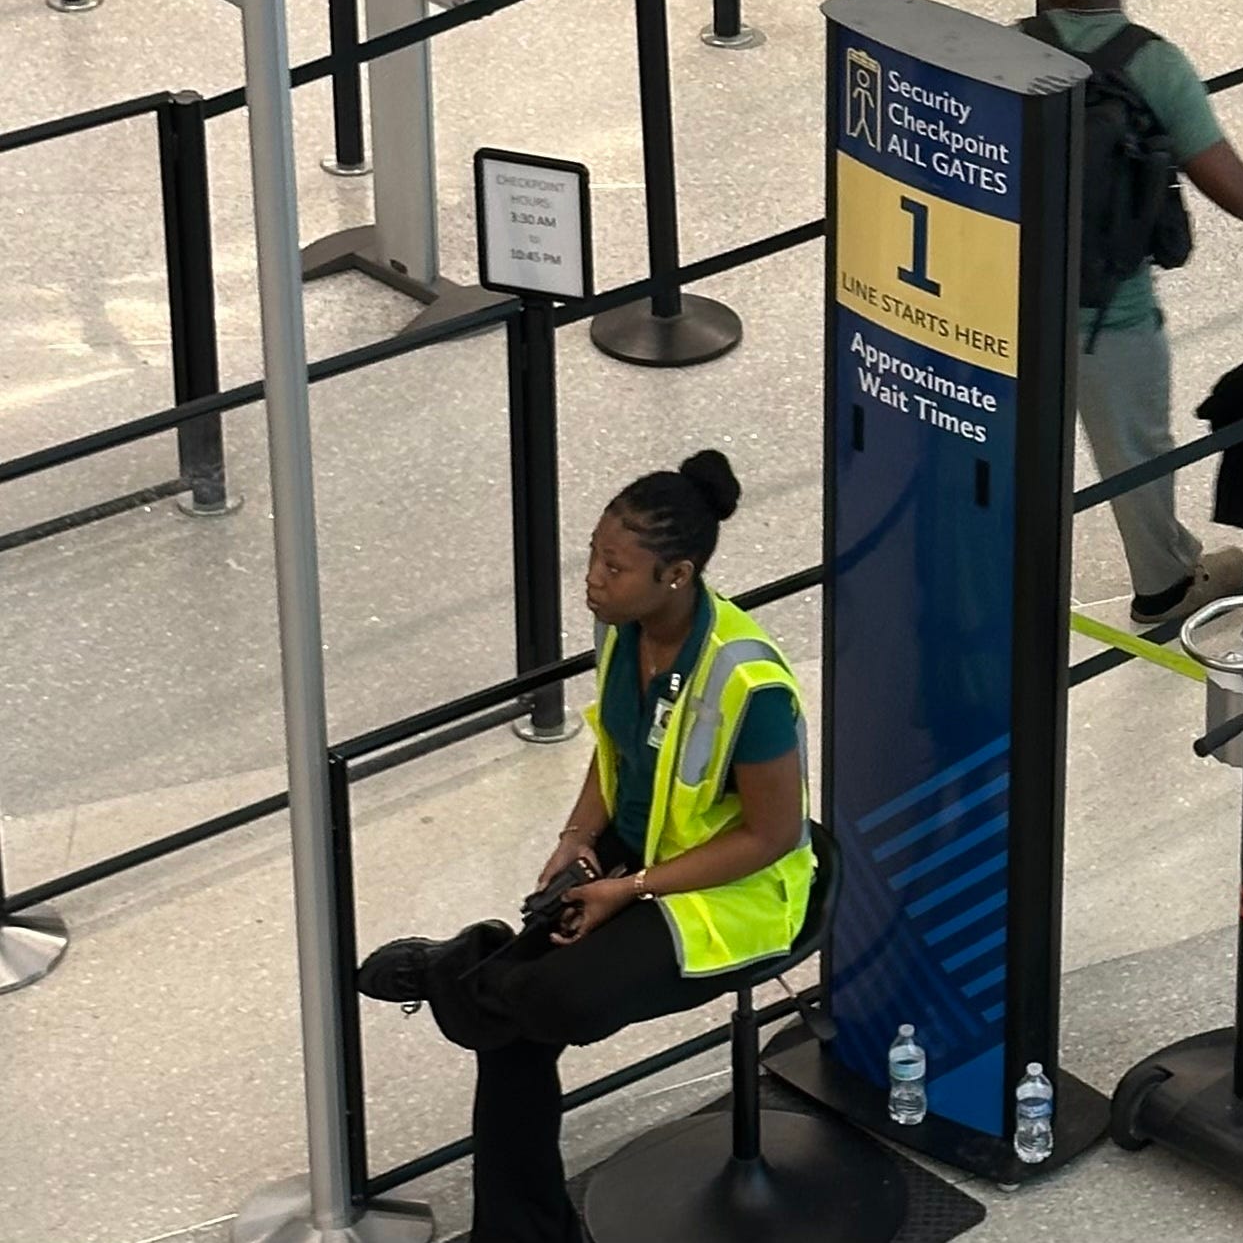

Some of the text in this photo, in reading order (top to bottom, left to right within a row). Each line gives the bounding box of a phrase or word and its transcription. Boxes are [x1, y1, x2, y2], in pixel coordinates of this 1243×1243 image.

[887, 70, 972, 124] Security
[887, 133, 1008, 195] ALL GATES
[888, 102, 1010, 164] Checkpoint
[496, 174, 565, 192] CHECKPOINT
[511, 211, 557, 228] 3:30 AM
[897, 195, 941, 298] 1
[511, 248, 562, 265] 10:45 PM
[842, 271, 1010, 359] LINE STARTS HERE
[851, 331, 997, 413] Approximate
[858, 366, 987, 443] Wait Times
